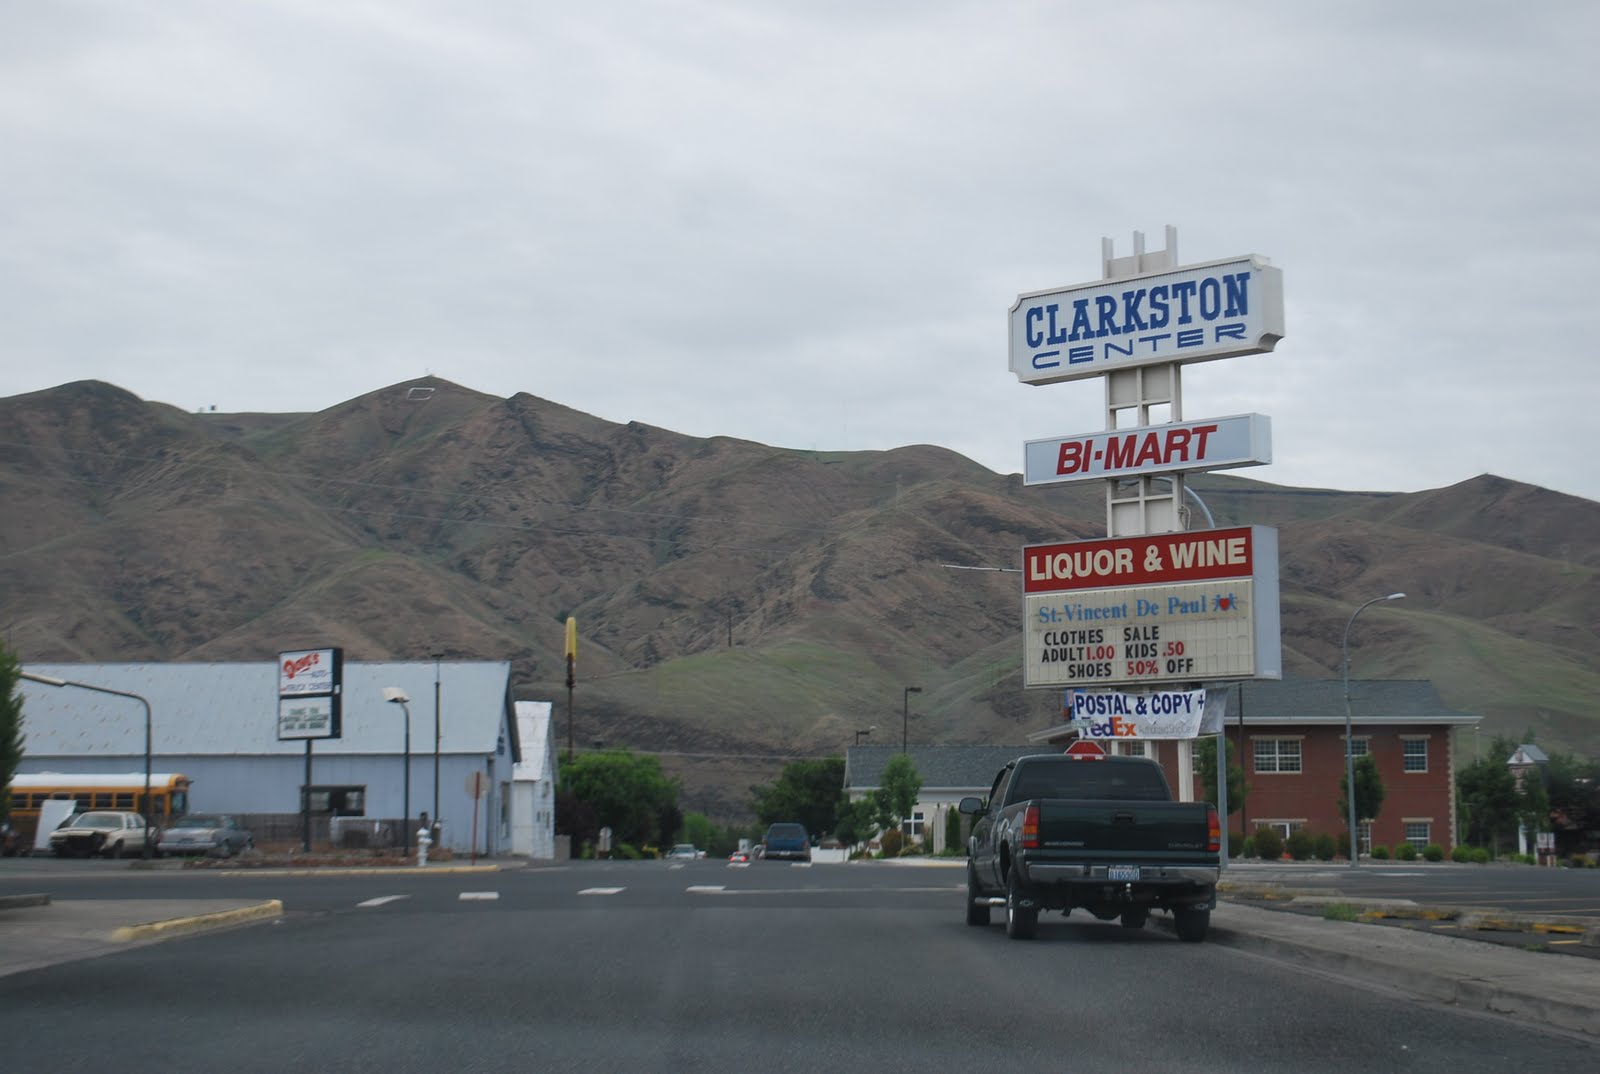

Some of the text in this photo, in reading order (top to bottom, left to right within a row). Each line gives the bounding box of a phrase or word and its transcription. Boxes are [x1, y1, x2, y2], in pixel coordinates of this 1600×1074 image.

[1026, 272, 1250, 348] CLARKSTON
[1032, 322, 1248, 369] CENTER
[1031, 537, 1247, 581] LIQUOR & WINE
[1136, 599, 1159, 617] De
[1168, 595, 1207, 615] Paul
[1044, 626, 1159, 646] CLOTHES SALE
[1125, 643, 1158, 658] KIDS
[1068, 658, 1194, 678] SHOES 50% OFF
[1075, 694, 1132, 715] POSTAL
[1135, 696, 1147, 715] &
[1151, 693, 1193, 715] COPY
